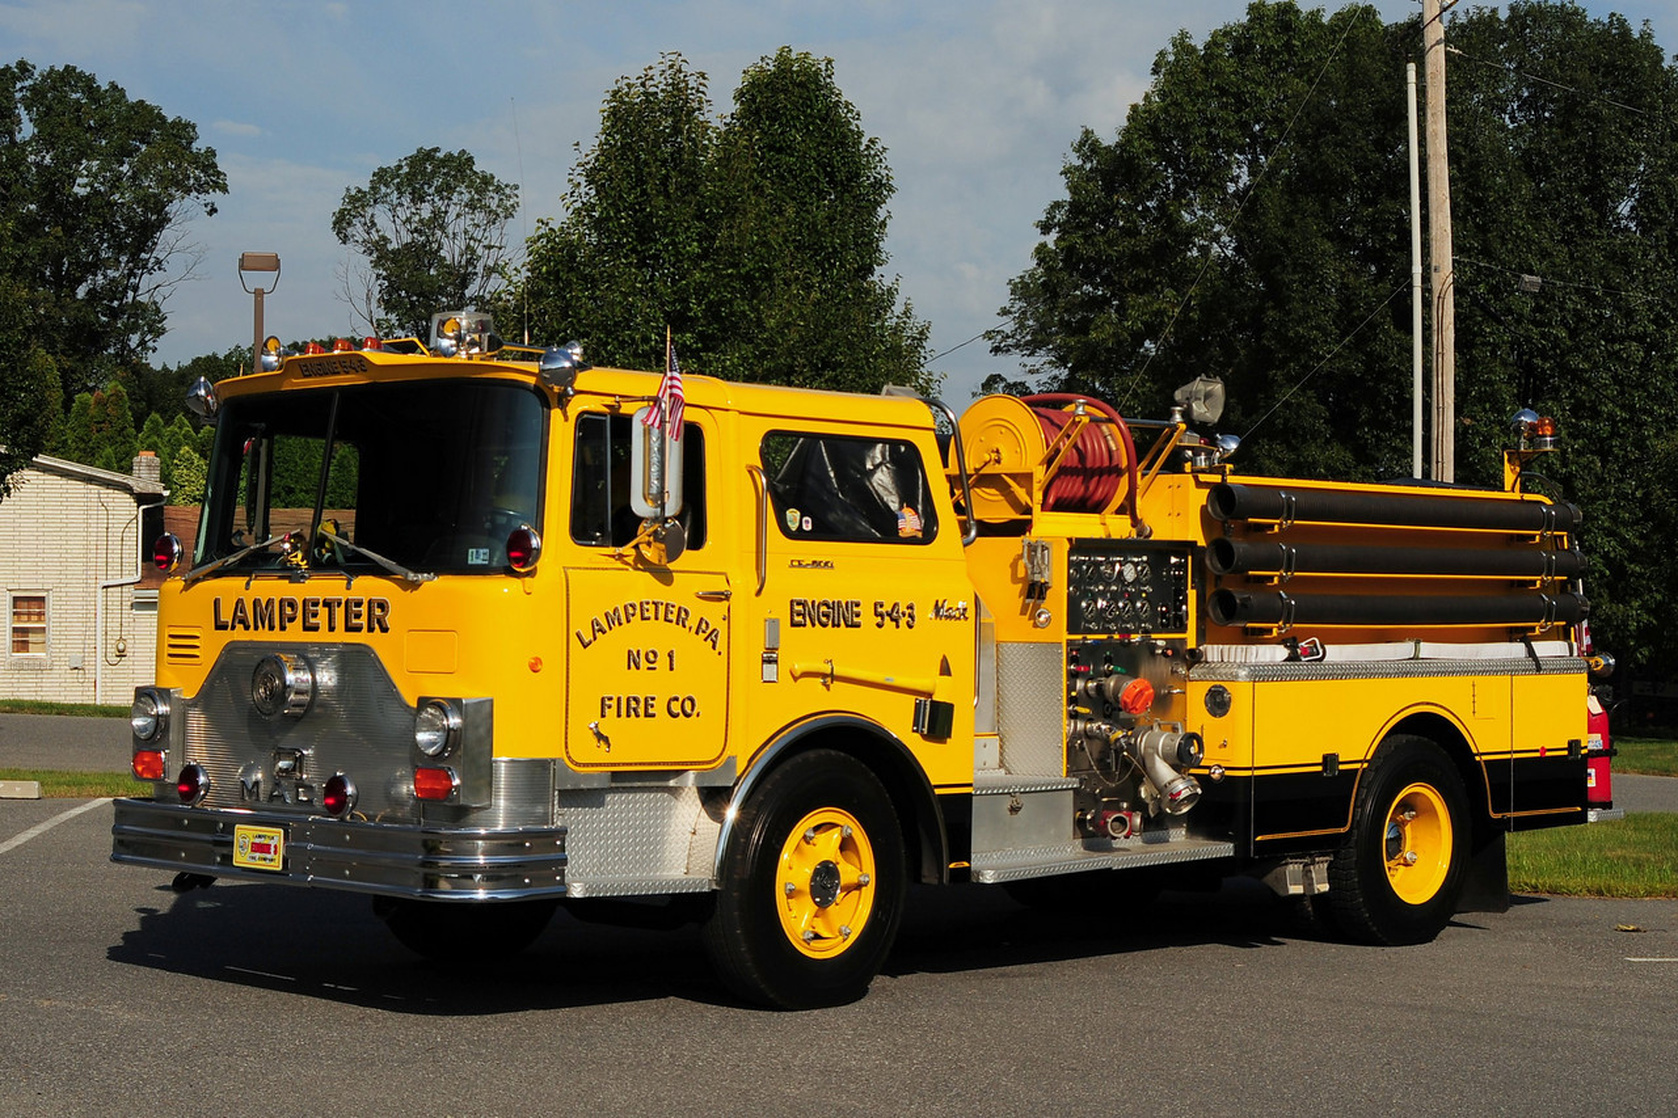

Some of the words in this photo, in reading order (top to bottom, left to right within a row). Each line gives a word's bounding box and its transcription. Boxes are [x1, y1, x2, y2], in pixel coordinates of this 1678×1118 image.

[213, 597, 391, 633] LAMPETER
[790, 599, 862, 628] ENGINE
[695, 617, 722, 656] PA.
[667, 649, 675, 671] 1
[600, 695, 657, 719] FIRE
